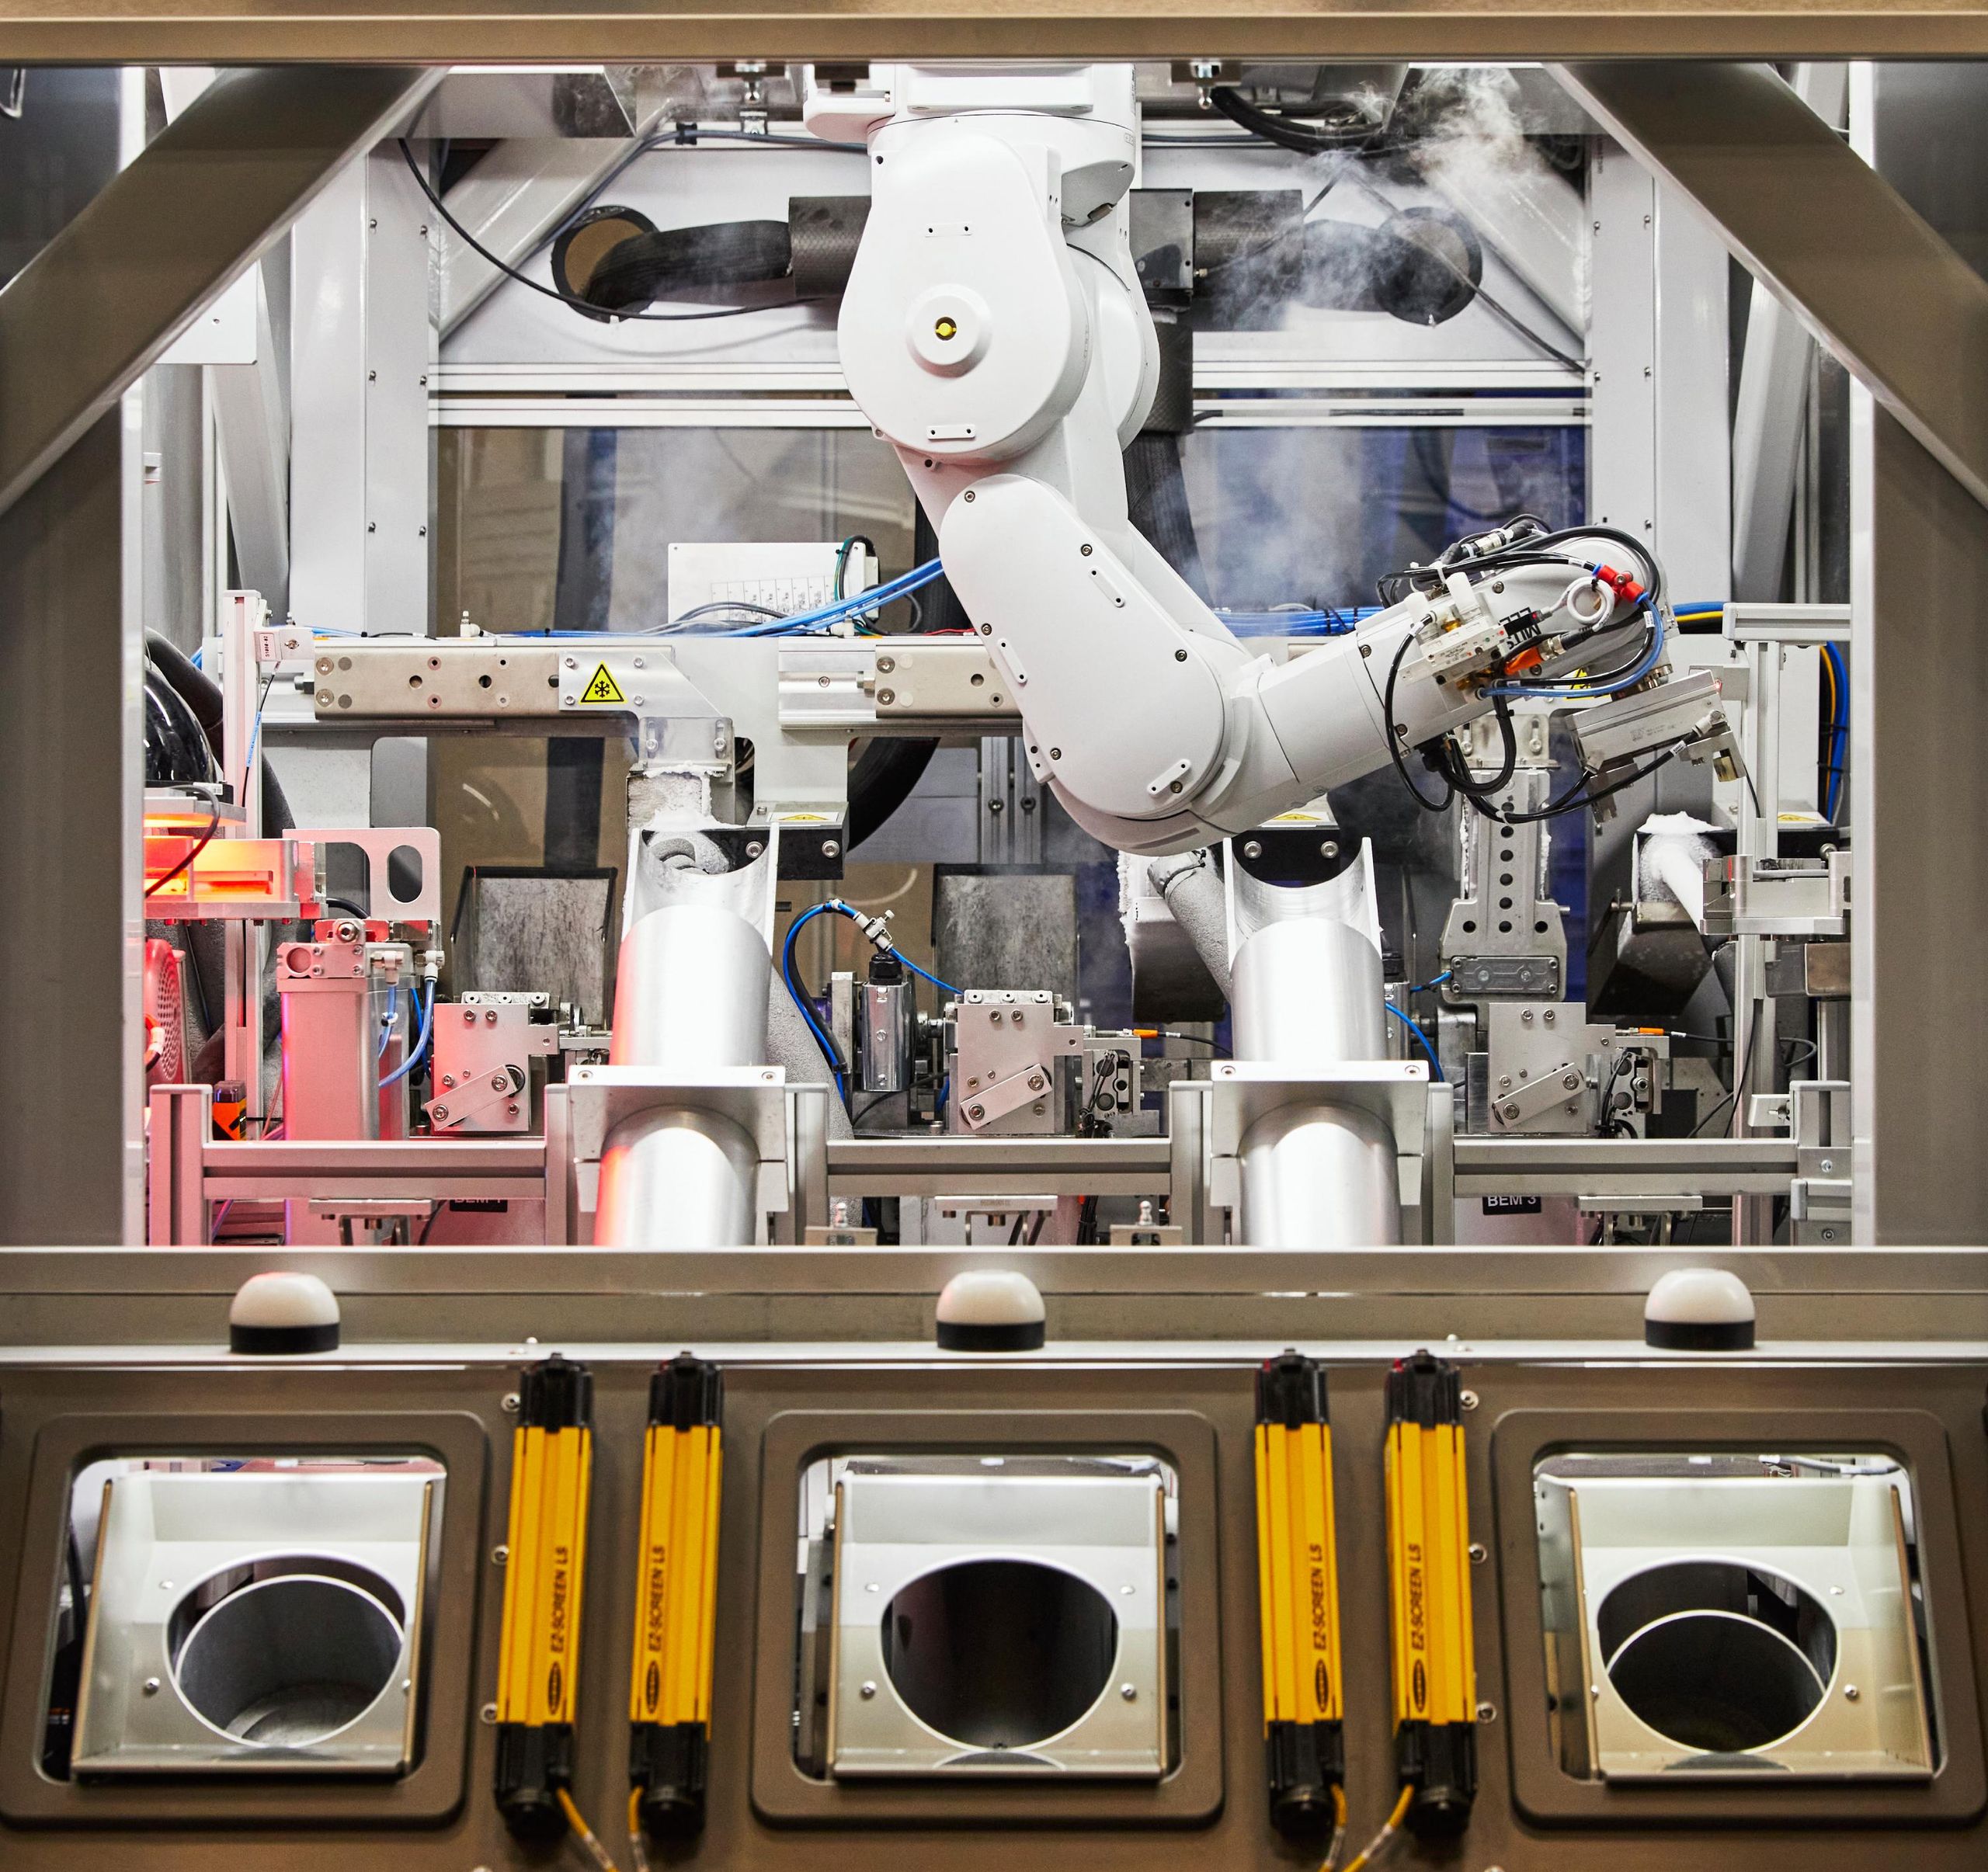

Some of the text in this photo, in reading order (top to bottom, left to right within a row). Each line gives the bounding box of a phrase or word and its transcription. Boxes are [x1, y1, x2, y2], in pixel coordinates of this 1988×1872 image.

[1488, 1196, 1522, 1207] BEM
[556, 1546, 568, 1565] LS
[652, 1545, 666, 1565] LS
[1309, 1544, 1322, 1563] LS
[1408, 1544, 1420, 1563] LS
